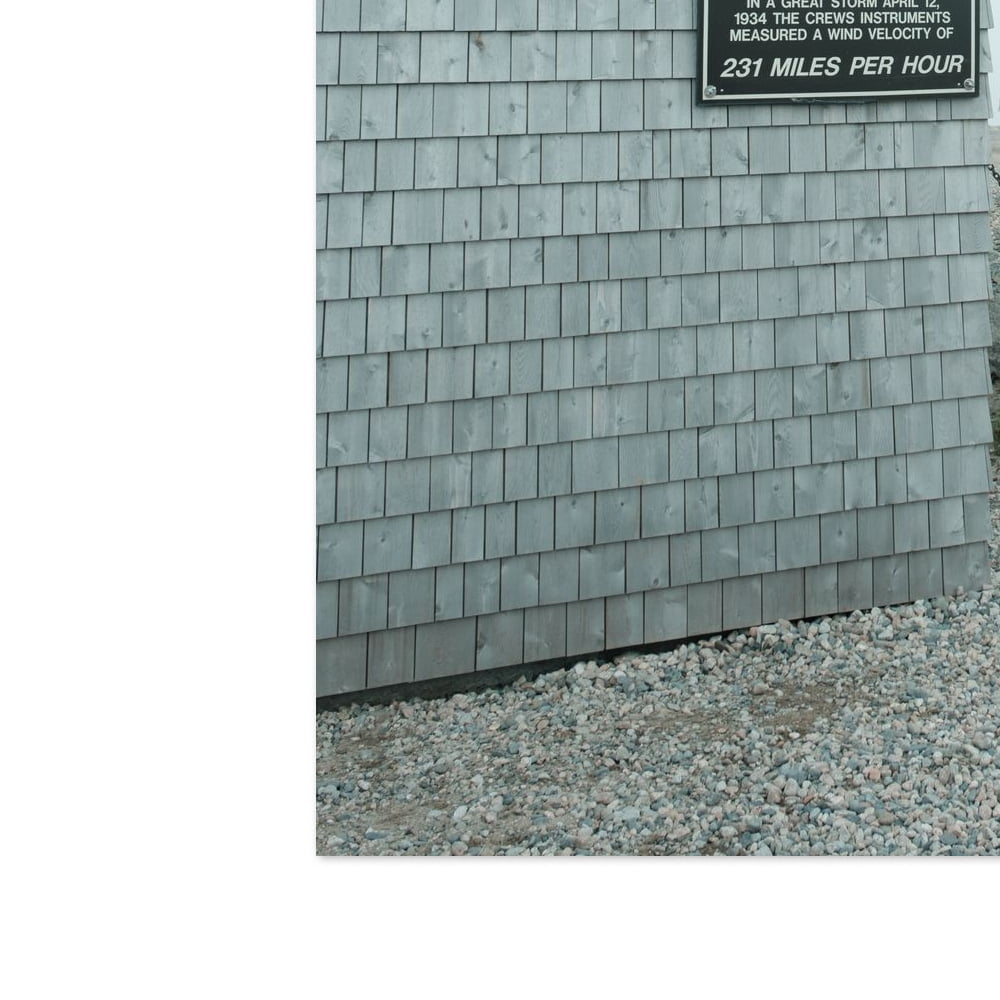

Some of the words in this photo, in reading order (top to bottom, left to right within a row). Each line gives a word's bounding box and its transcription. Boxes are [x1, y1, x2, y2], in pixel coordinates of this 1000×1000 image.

[734, 12, 767, 25] 1934
[773, 12, 799, 24] THE
[806, 12, 854, 24] CREWS
[861, 9, 950, 24] INSTRUMENTS
[730, 29, 807, 41] MEASURED
[813, 28, 822, 40] A
[828, 28, 862, 40] WIND
[868, 27, 931, 39] VELOCITY
[937, 27, 954, 39] OF
[720, 58, 763, 77] 231
[770, 57, 841, 76] MILES
[849, 56, 894, 75] PER
[902, 55, 964, 74] HOUR
